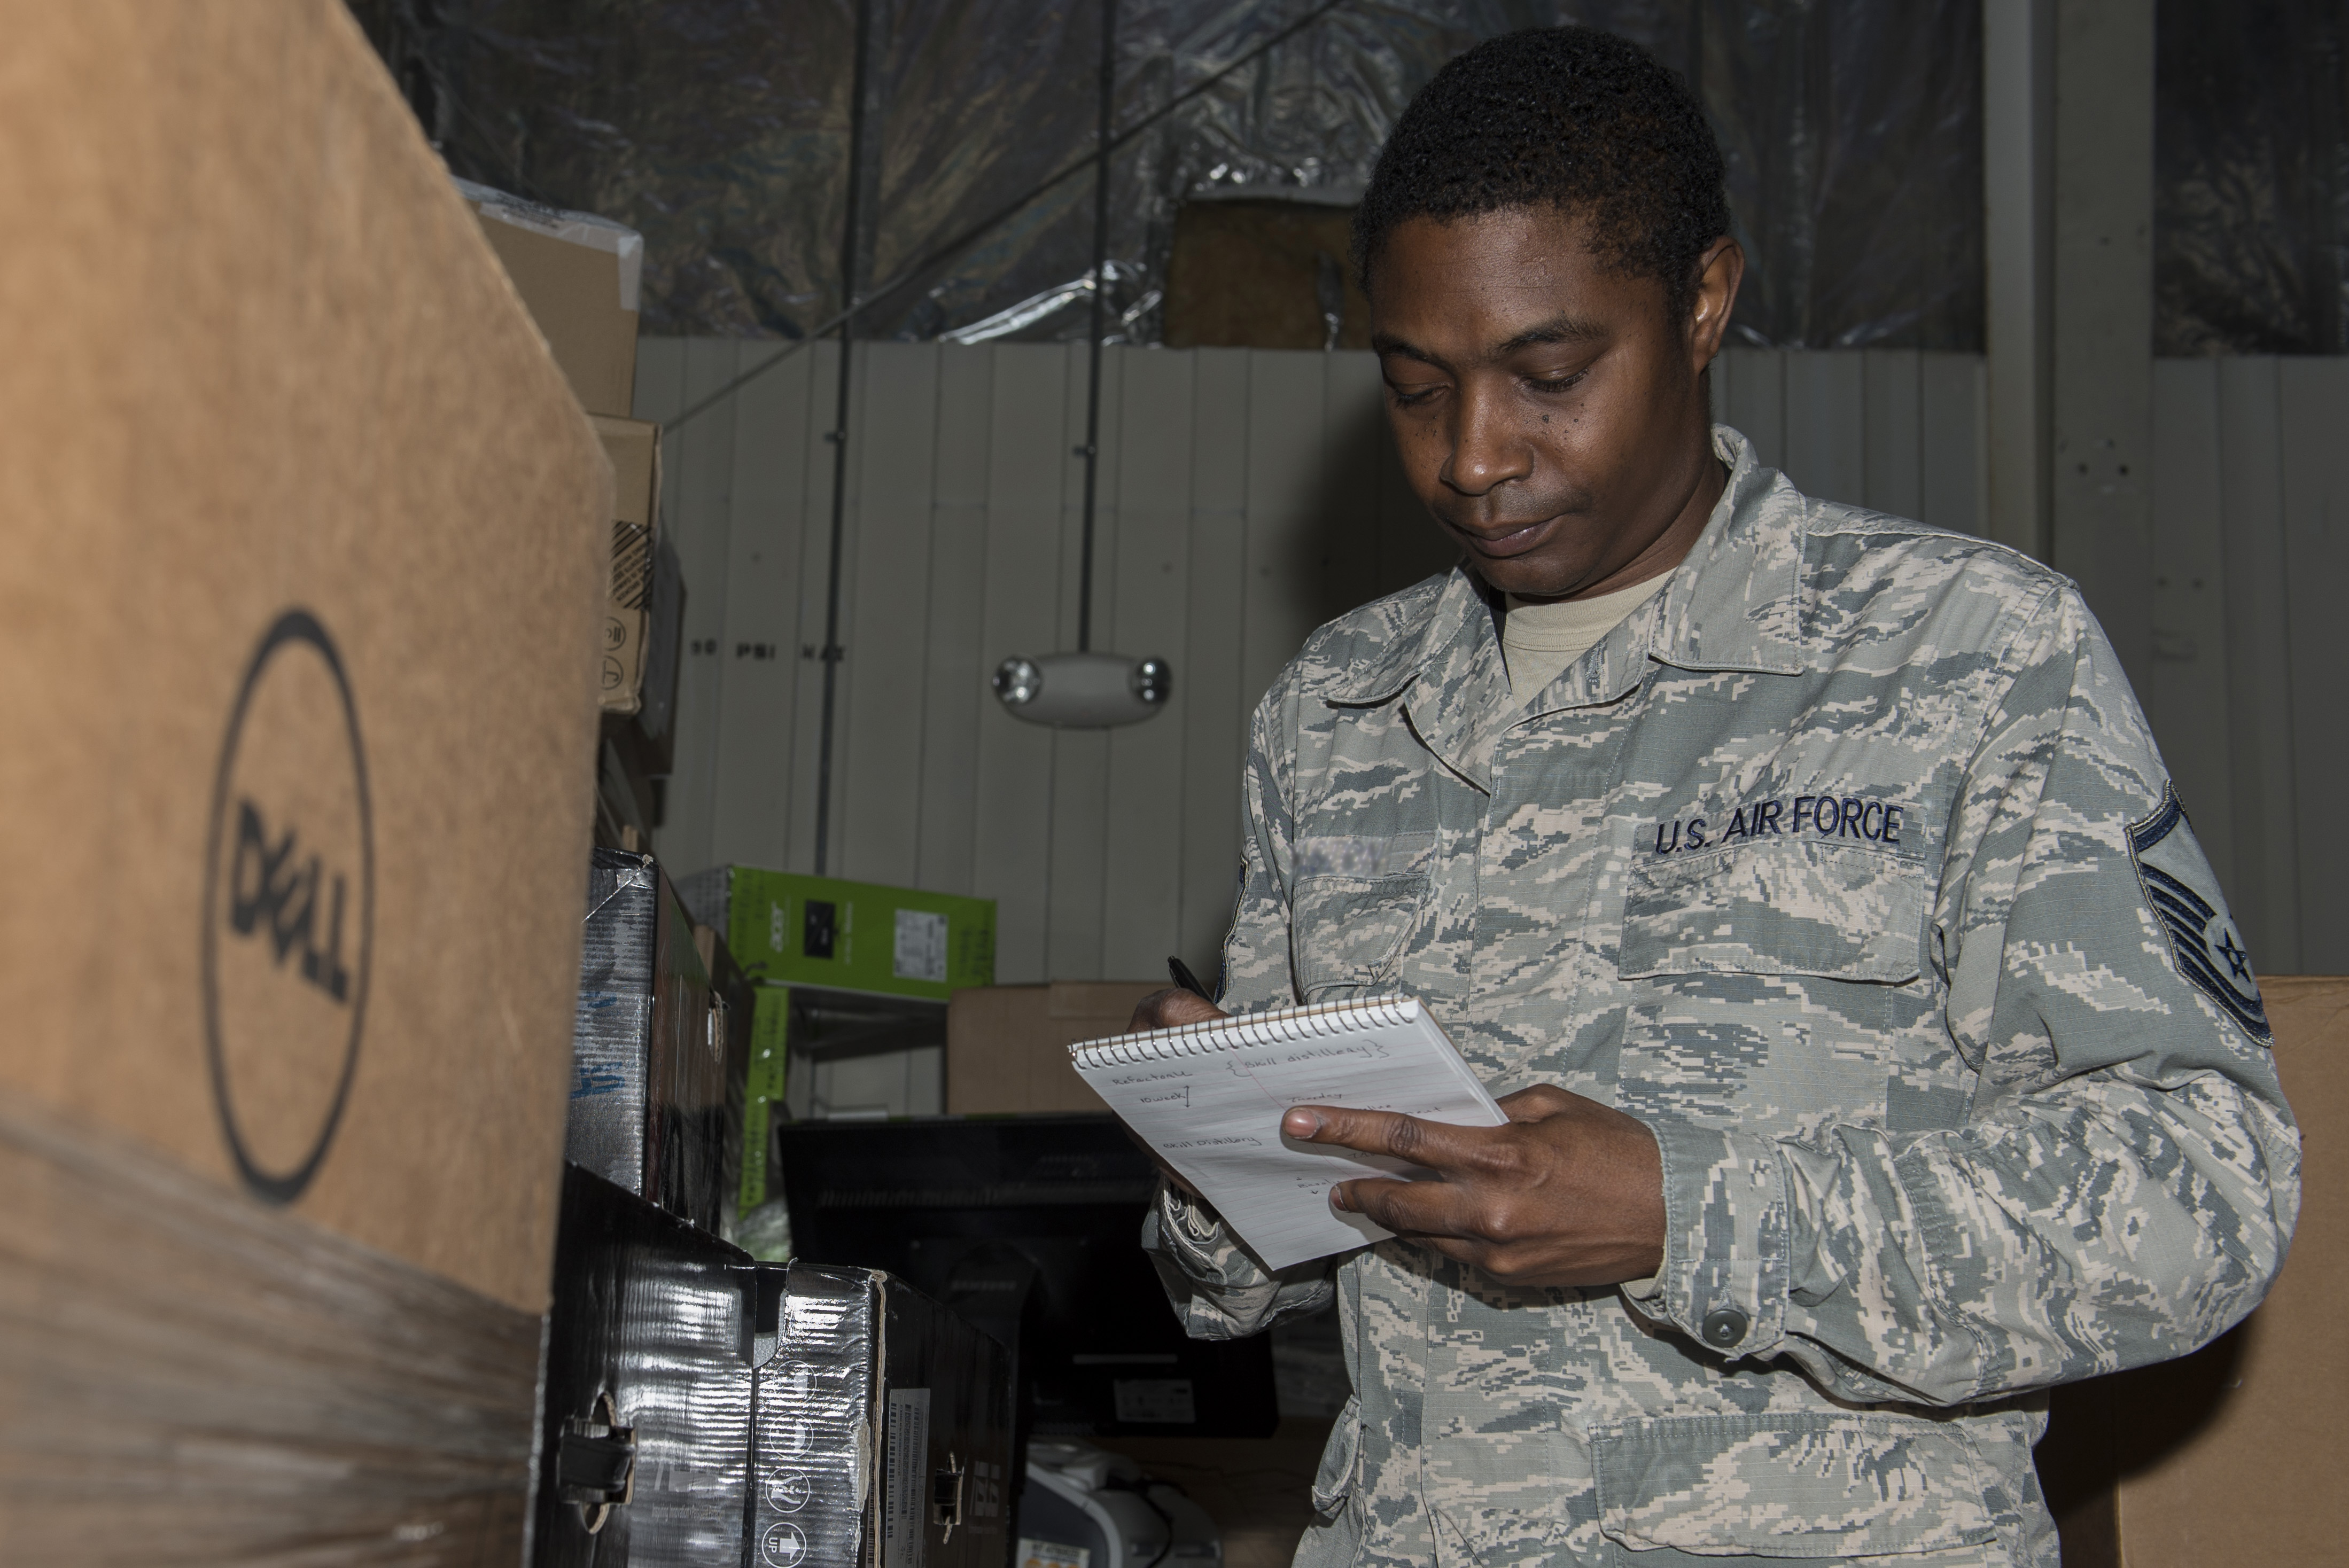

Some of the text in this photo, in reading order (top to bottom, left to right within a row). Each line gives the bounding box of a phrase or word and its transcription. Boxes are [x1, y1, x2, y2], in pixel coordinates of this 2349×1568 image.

[1656, 795, 1904, 855] U.S. AIR FORCE
[231, 799, 348, 1003] DELL
[1244, 1057, 1277, 1068] Skill
[1163, 1141, 1193, 1149] Skill
[768, 1537, 778, 1553] UP
